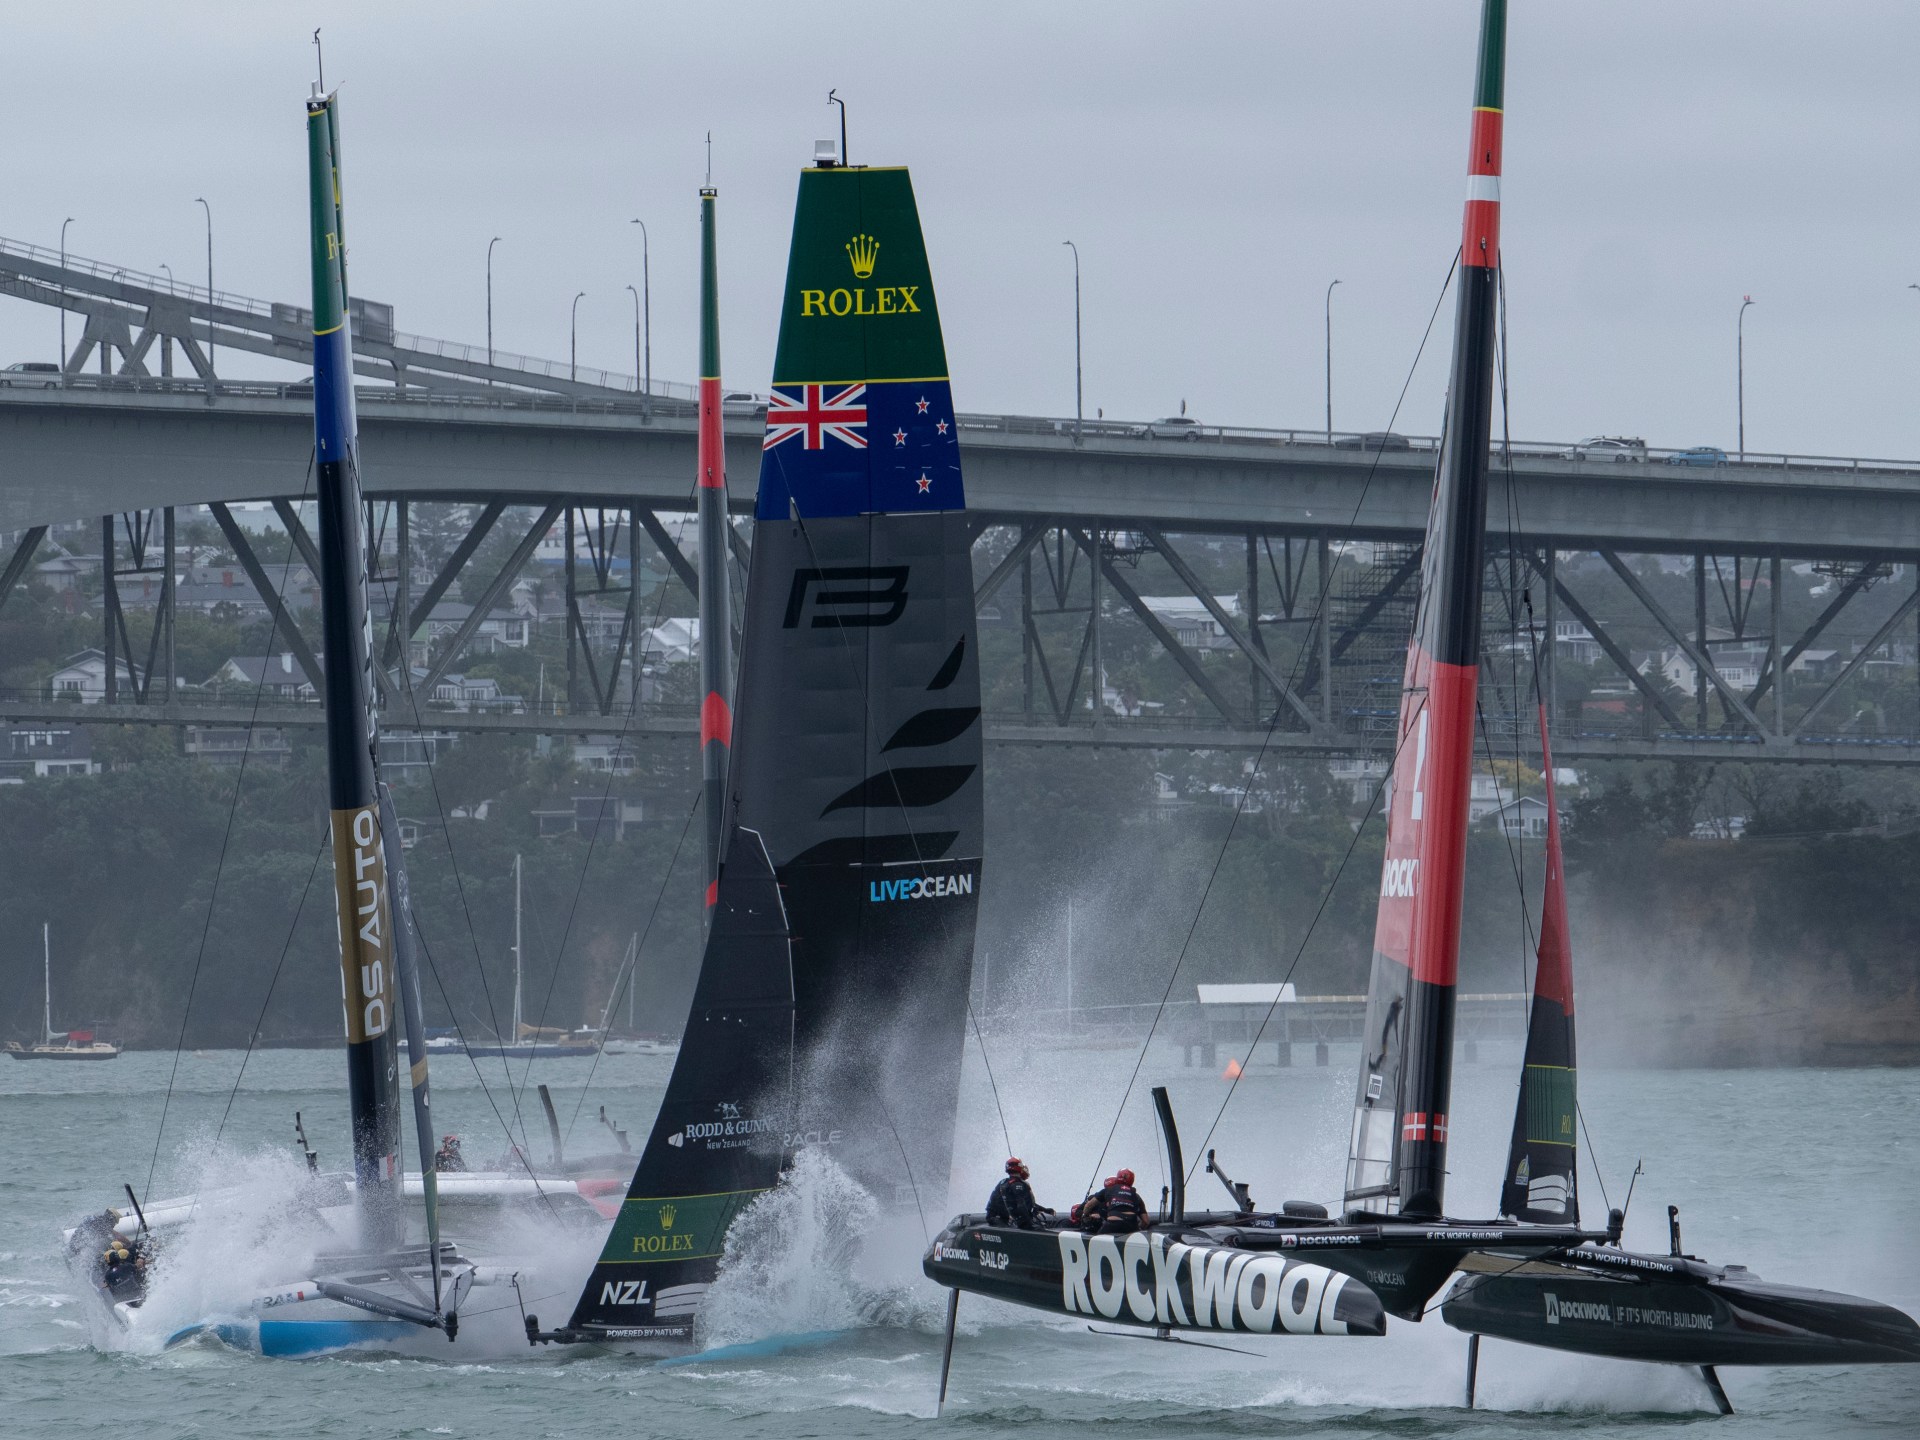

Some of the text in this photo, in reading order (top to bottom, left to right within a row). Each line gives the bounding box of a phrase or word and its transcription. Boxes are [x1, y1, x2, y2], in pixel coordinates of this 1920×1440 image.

[800, 286, 921, 317] ROLEX
[1381, 858, 1419, 897] ROCK
[353, 809, 387, 1036] DS AUTO
[685, 1121, 724, 1139] RODD
[724, 1119, 735, 1136] &
[783, 1130, 843, 1148] RACLE
[706, 1139, 751, 1151] NEW ZEALAND
[632, 1234, 694, 1253] ROLEX
[1299, 1235, 1361, 1246] ROCKWOOL
[1426, 1232, 1433, 1240] IF
[1447, 1232, 1471, 1240] WORTH
[1472, 1231, 1503, 1240] BUILDING
[942, 1247, 970, 1261] ROCKWOOL
[1566, 1249, 1674, 1273] IF IT'S WORTH BUILDING
[1058, 1230, 1351, 1335] ROCKWOOL
[599, 1280, 651, 1306] NZL
[1559, 1301, 1713, 1330] ROCKWOOL IF IT'S WORTH BUILDING
[606, 1329, 644, 1338] POWERED
[644, 1329, 654, 1337] BY
